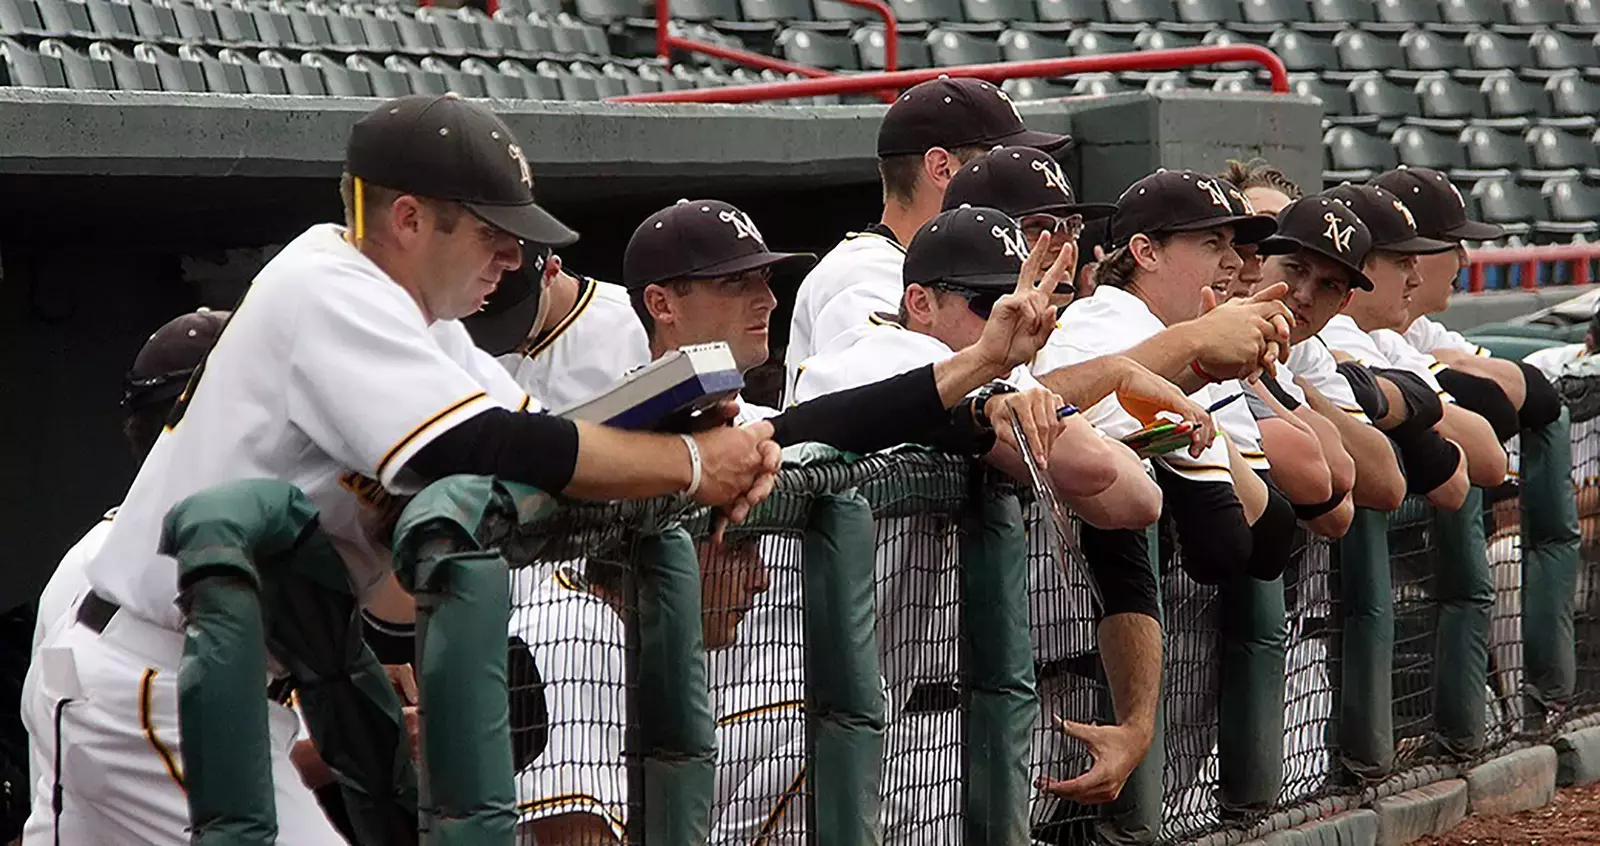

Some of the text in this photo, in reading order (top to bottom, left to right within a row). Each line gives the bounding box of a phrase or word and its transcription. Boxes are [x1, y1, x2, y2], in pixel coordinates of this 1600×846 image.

[1031, 159, 1070, 196] M
[719, 210, 763, 244] M
[991, 225, 1031, 262] M
[1324, 212, 1356, 253] M
